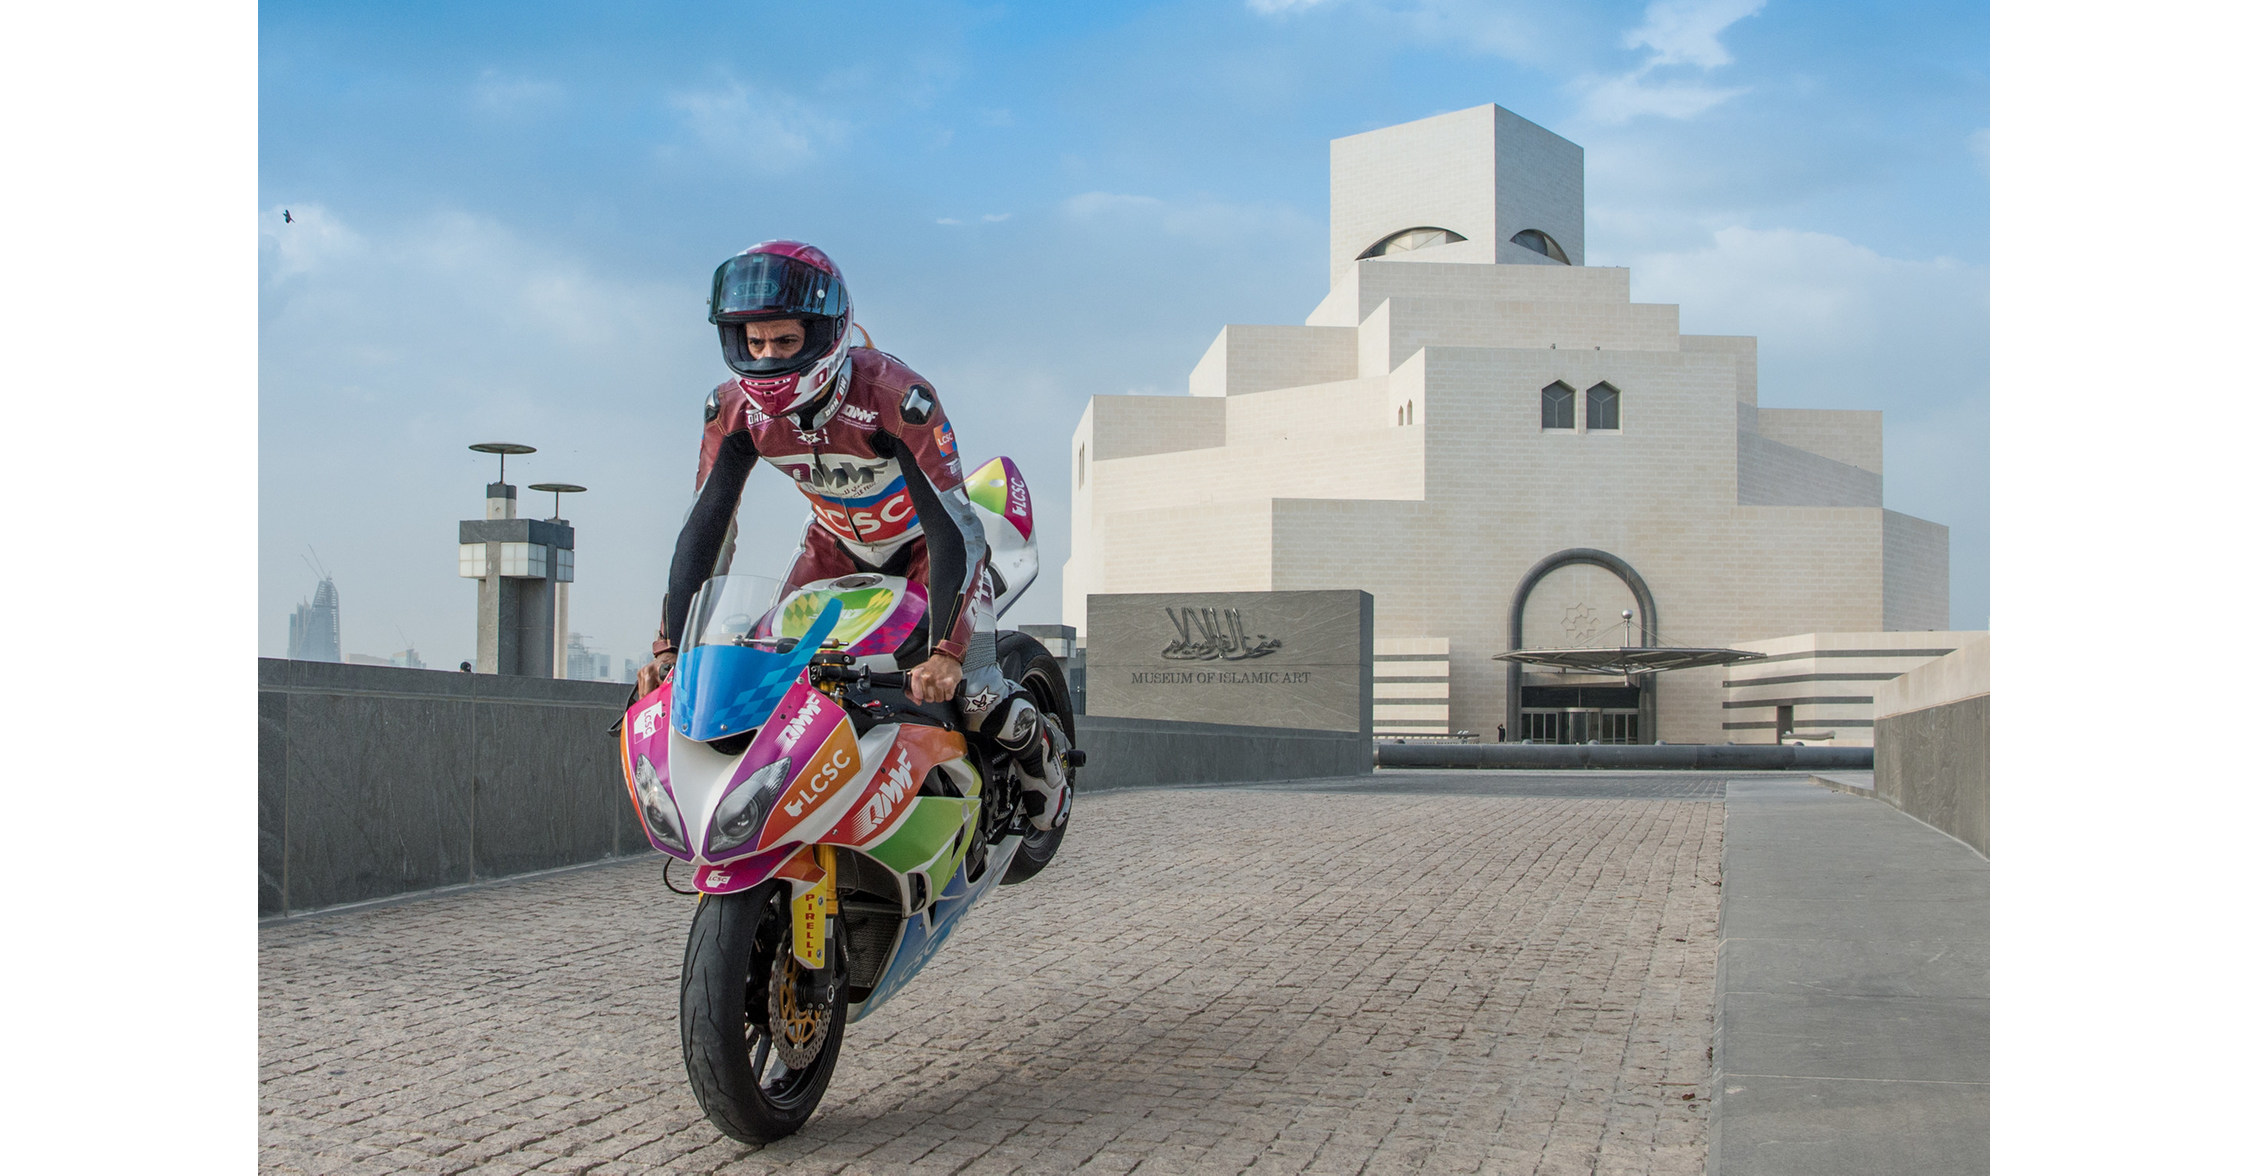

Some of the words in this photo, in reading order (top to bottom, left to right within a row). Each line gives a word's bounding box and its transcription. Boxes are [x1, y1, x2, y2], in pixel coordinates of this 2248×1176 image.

[937, 432, 953, 446] LCSC
[1010, 477, 1027, 508] LCSC
[1131, 672, 1193, 684] MUSEUM
[1196, 672, 1215, 684] OF
[1219, 672, 1278, 684] ISLAMIC
[1281, 672, 1311, 684] ART
[644, 710, 653, 735] LCSC
[799, 749, 850, 804] LCSC
[805, 894, 815, 957] PIRELLI
